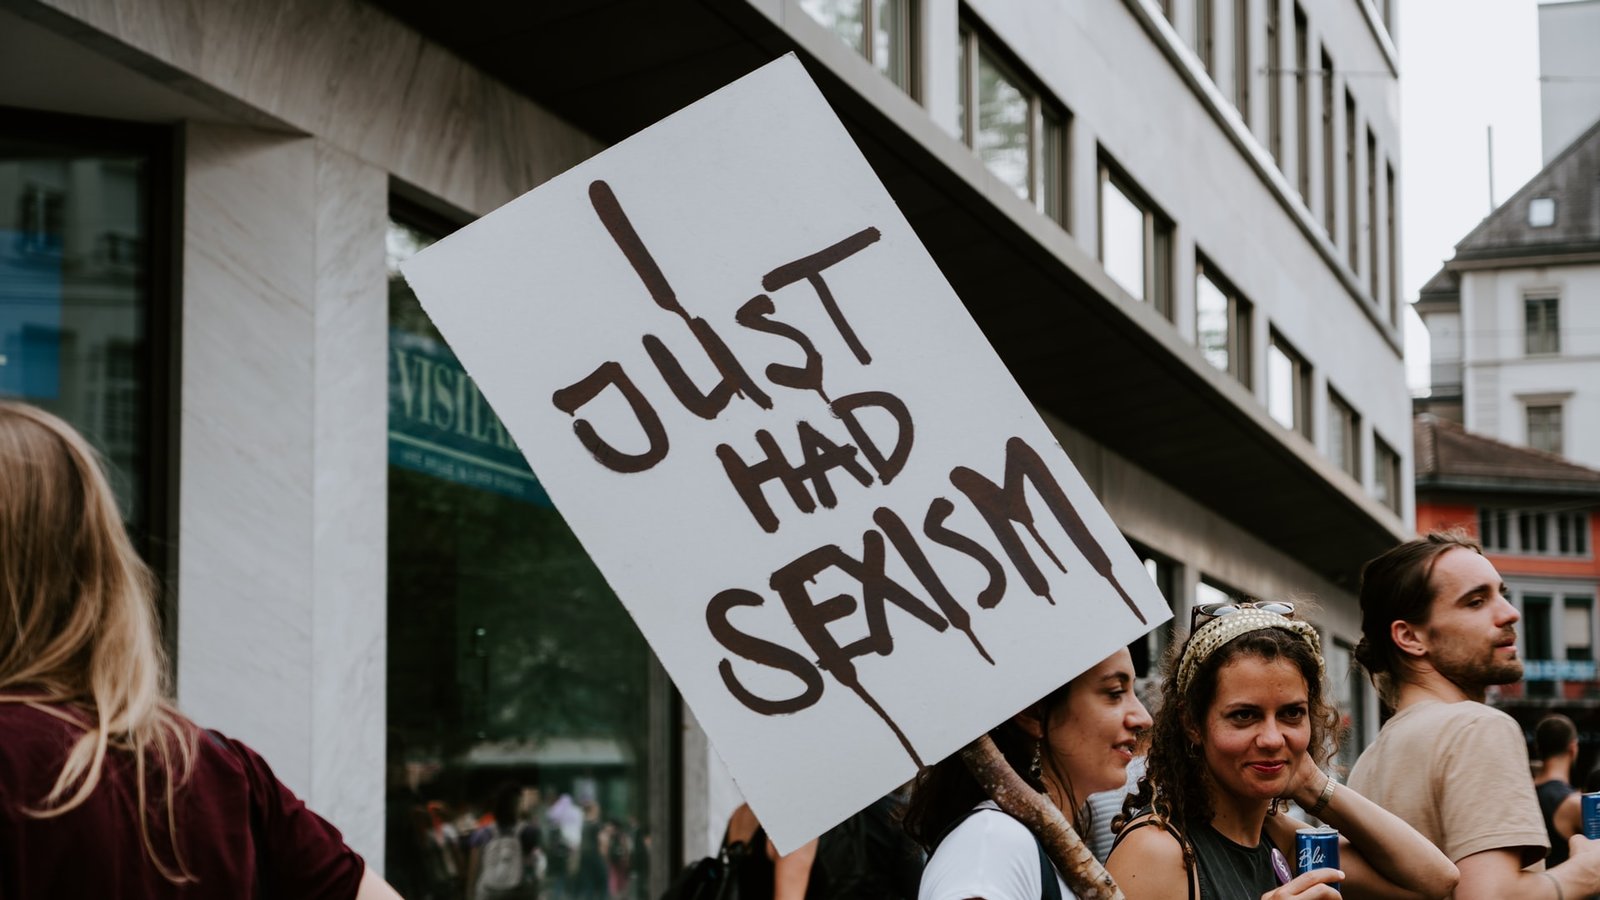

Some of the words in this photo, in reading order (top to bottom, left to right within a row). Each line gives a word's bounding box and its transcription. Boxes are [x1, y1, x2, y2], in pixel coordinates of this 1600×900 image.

[588, 179, 690, 321] I
[396, 350, 518, 452] VISILA
[552, 226, 881, 473] JUST
[715, 391, 914, 533] HAD
[706, 437, 1146, 718] SEXISM
[1298, 846, 1326, 868] Blu
